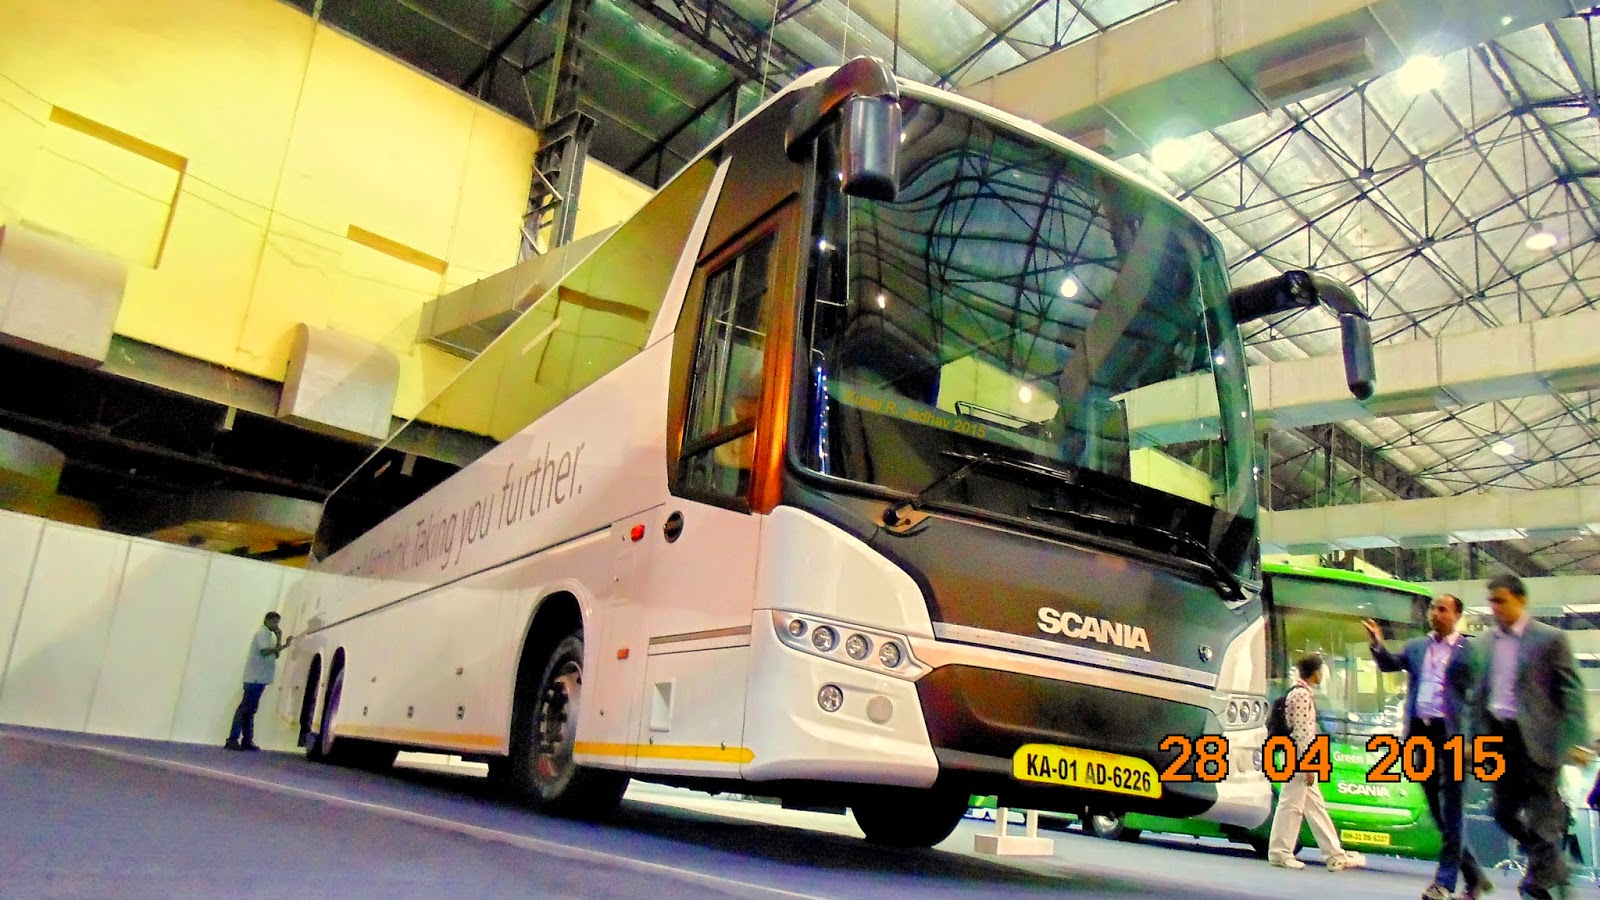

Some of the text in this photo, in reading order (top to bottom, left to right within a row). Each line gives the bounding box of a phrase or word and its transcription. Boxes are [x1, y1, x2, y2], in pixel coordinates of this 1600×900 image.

[413, 511, 458, 570] Taking
[455, 490, 495, 566] you
[498, 442, 586, 529] further.
[1037, 606, 1151, 652] SCANIA
[1026, 753, 1078, 782] KA-01
[1085, 761, 1151, 793] AD-6226
[1333, 751, 1364, 765] Green
[1337, 782, 1390, 797] SCANIA
